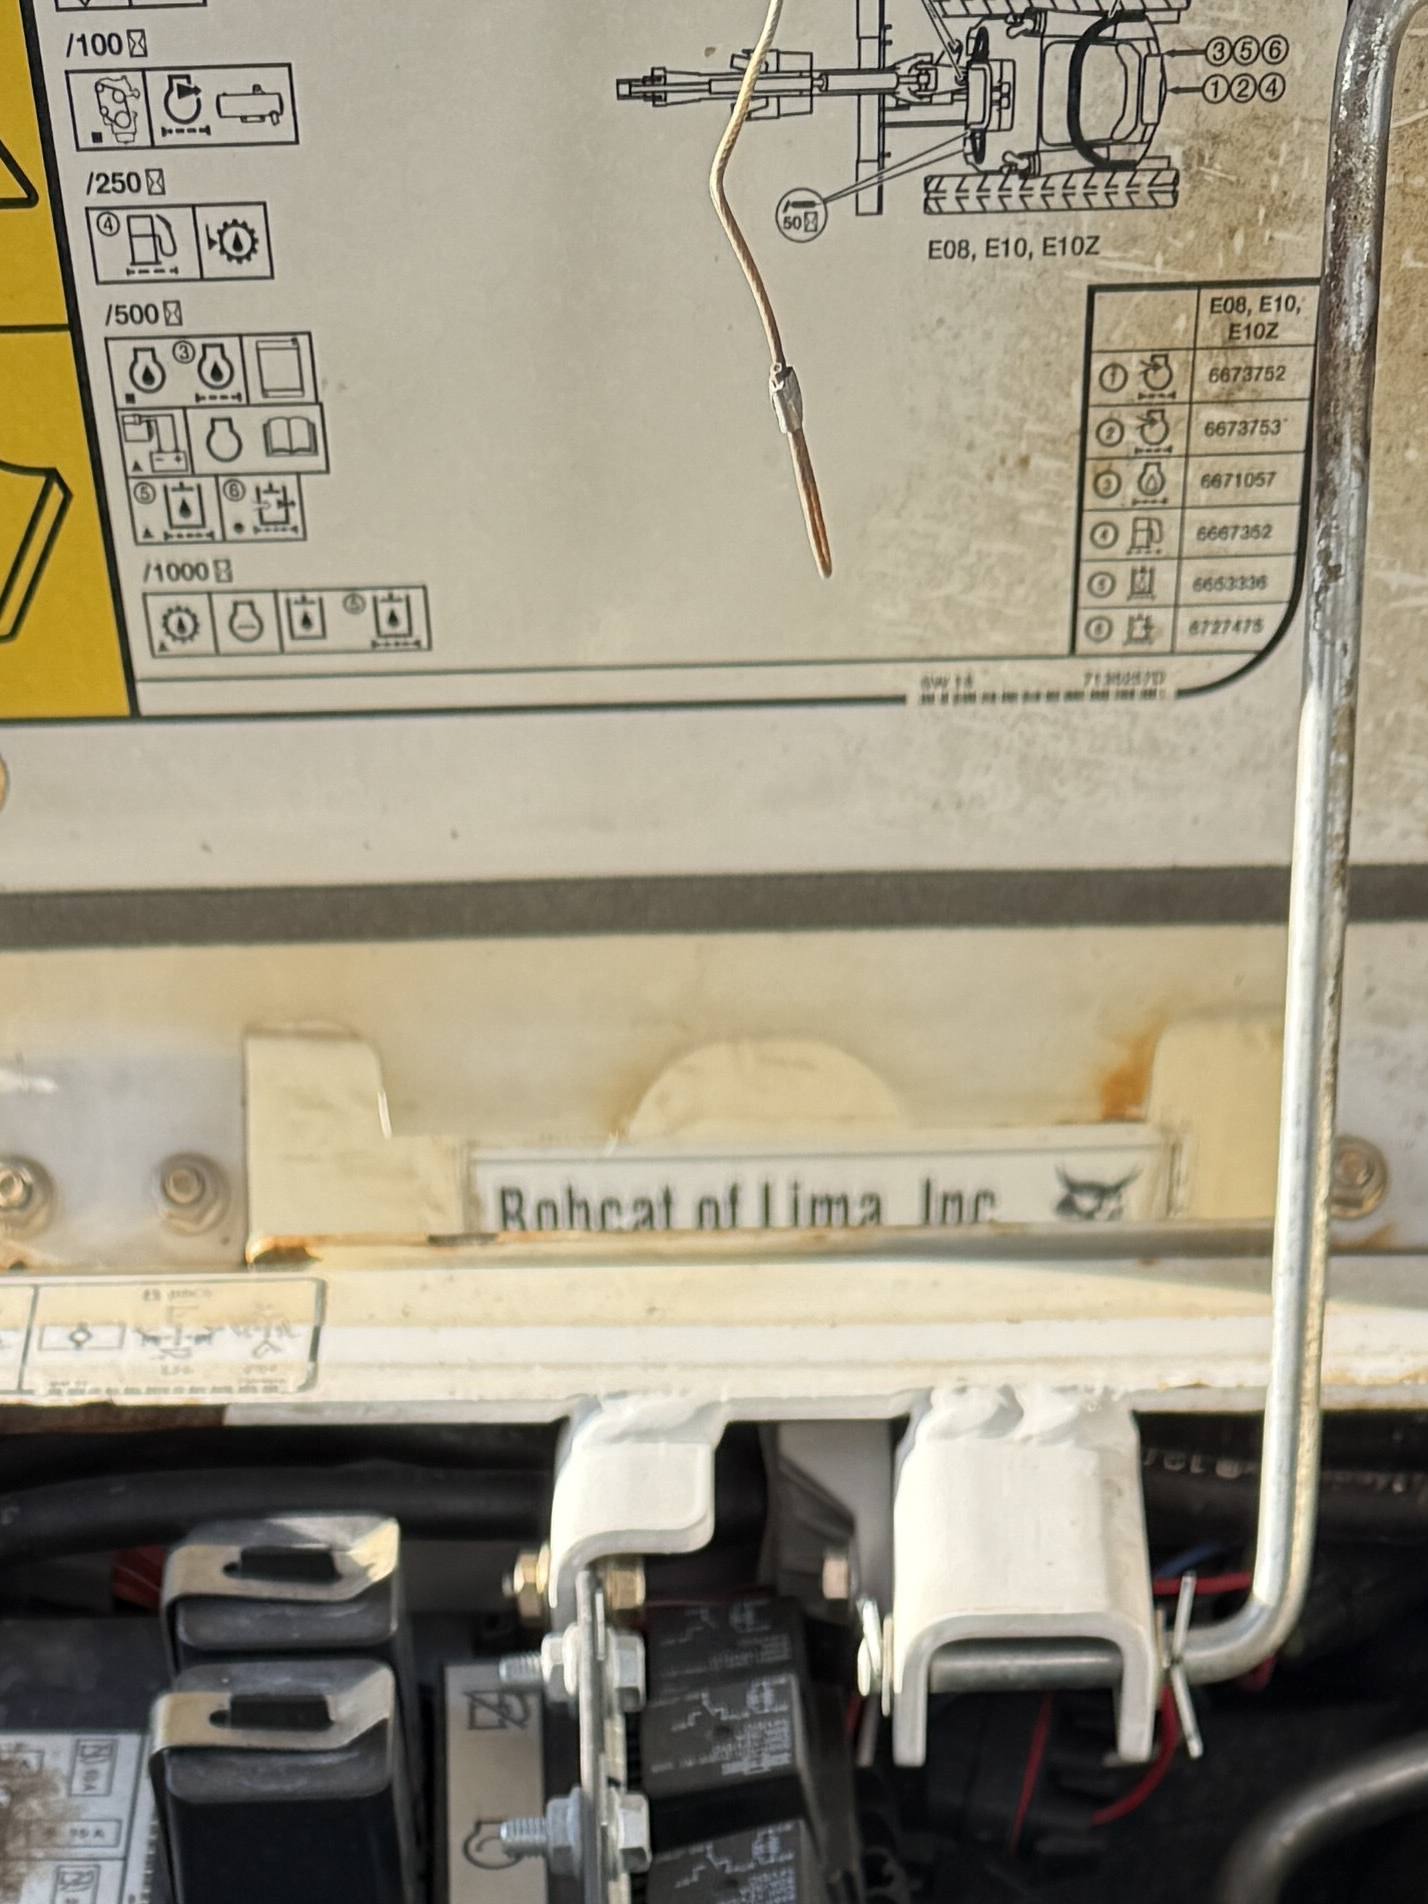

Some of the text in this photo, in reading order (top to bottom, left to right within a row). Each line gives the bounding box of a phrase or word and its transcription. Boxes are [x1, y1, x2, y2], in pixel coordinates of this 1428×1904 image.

[66, 33, 123, 57] /100
[86, 172, 141, 196] /250
[928, 235, 1101, 261] E08, E10, E10Z
[105, 303, 160, 327] /500
[1209, 297, 1252, 316] E08,
[1228, 322, 1279, 341] E10Z
[1208, 365, 1287, 384] 6673752
[142, 562, 209, 583] /1000
[499, 1183, 672, 1232] Bobcat
